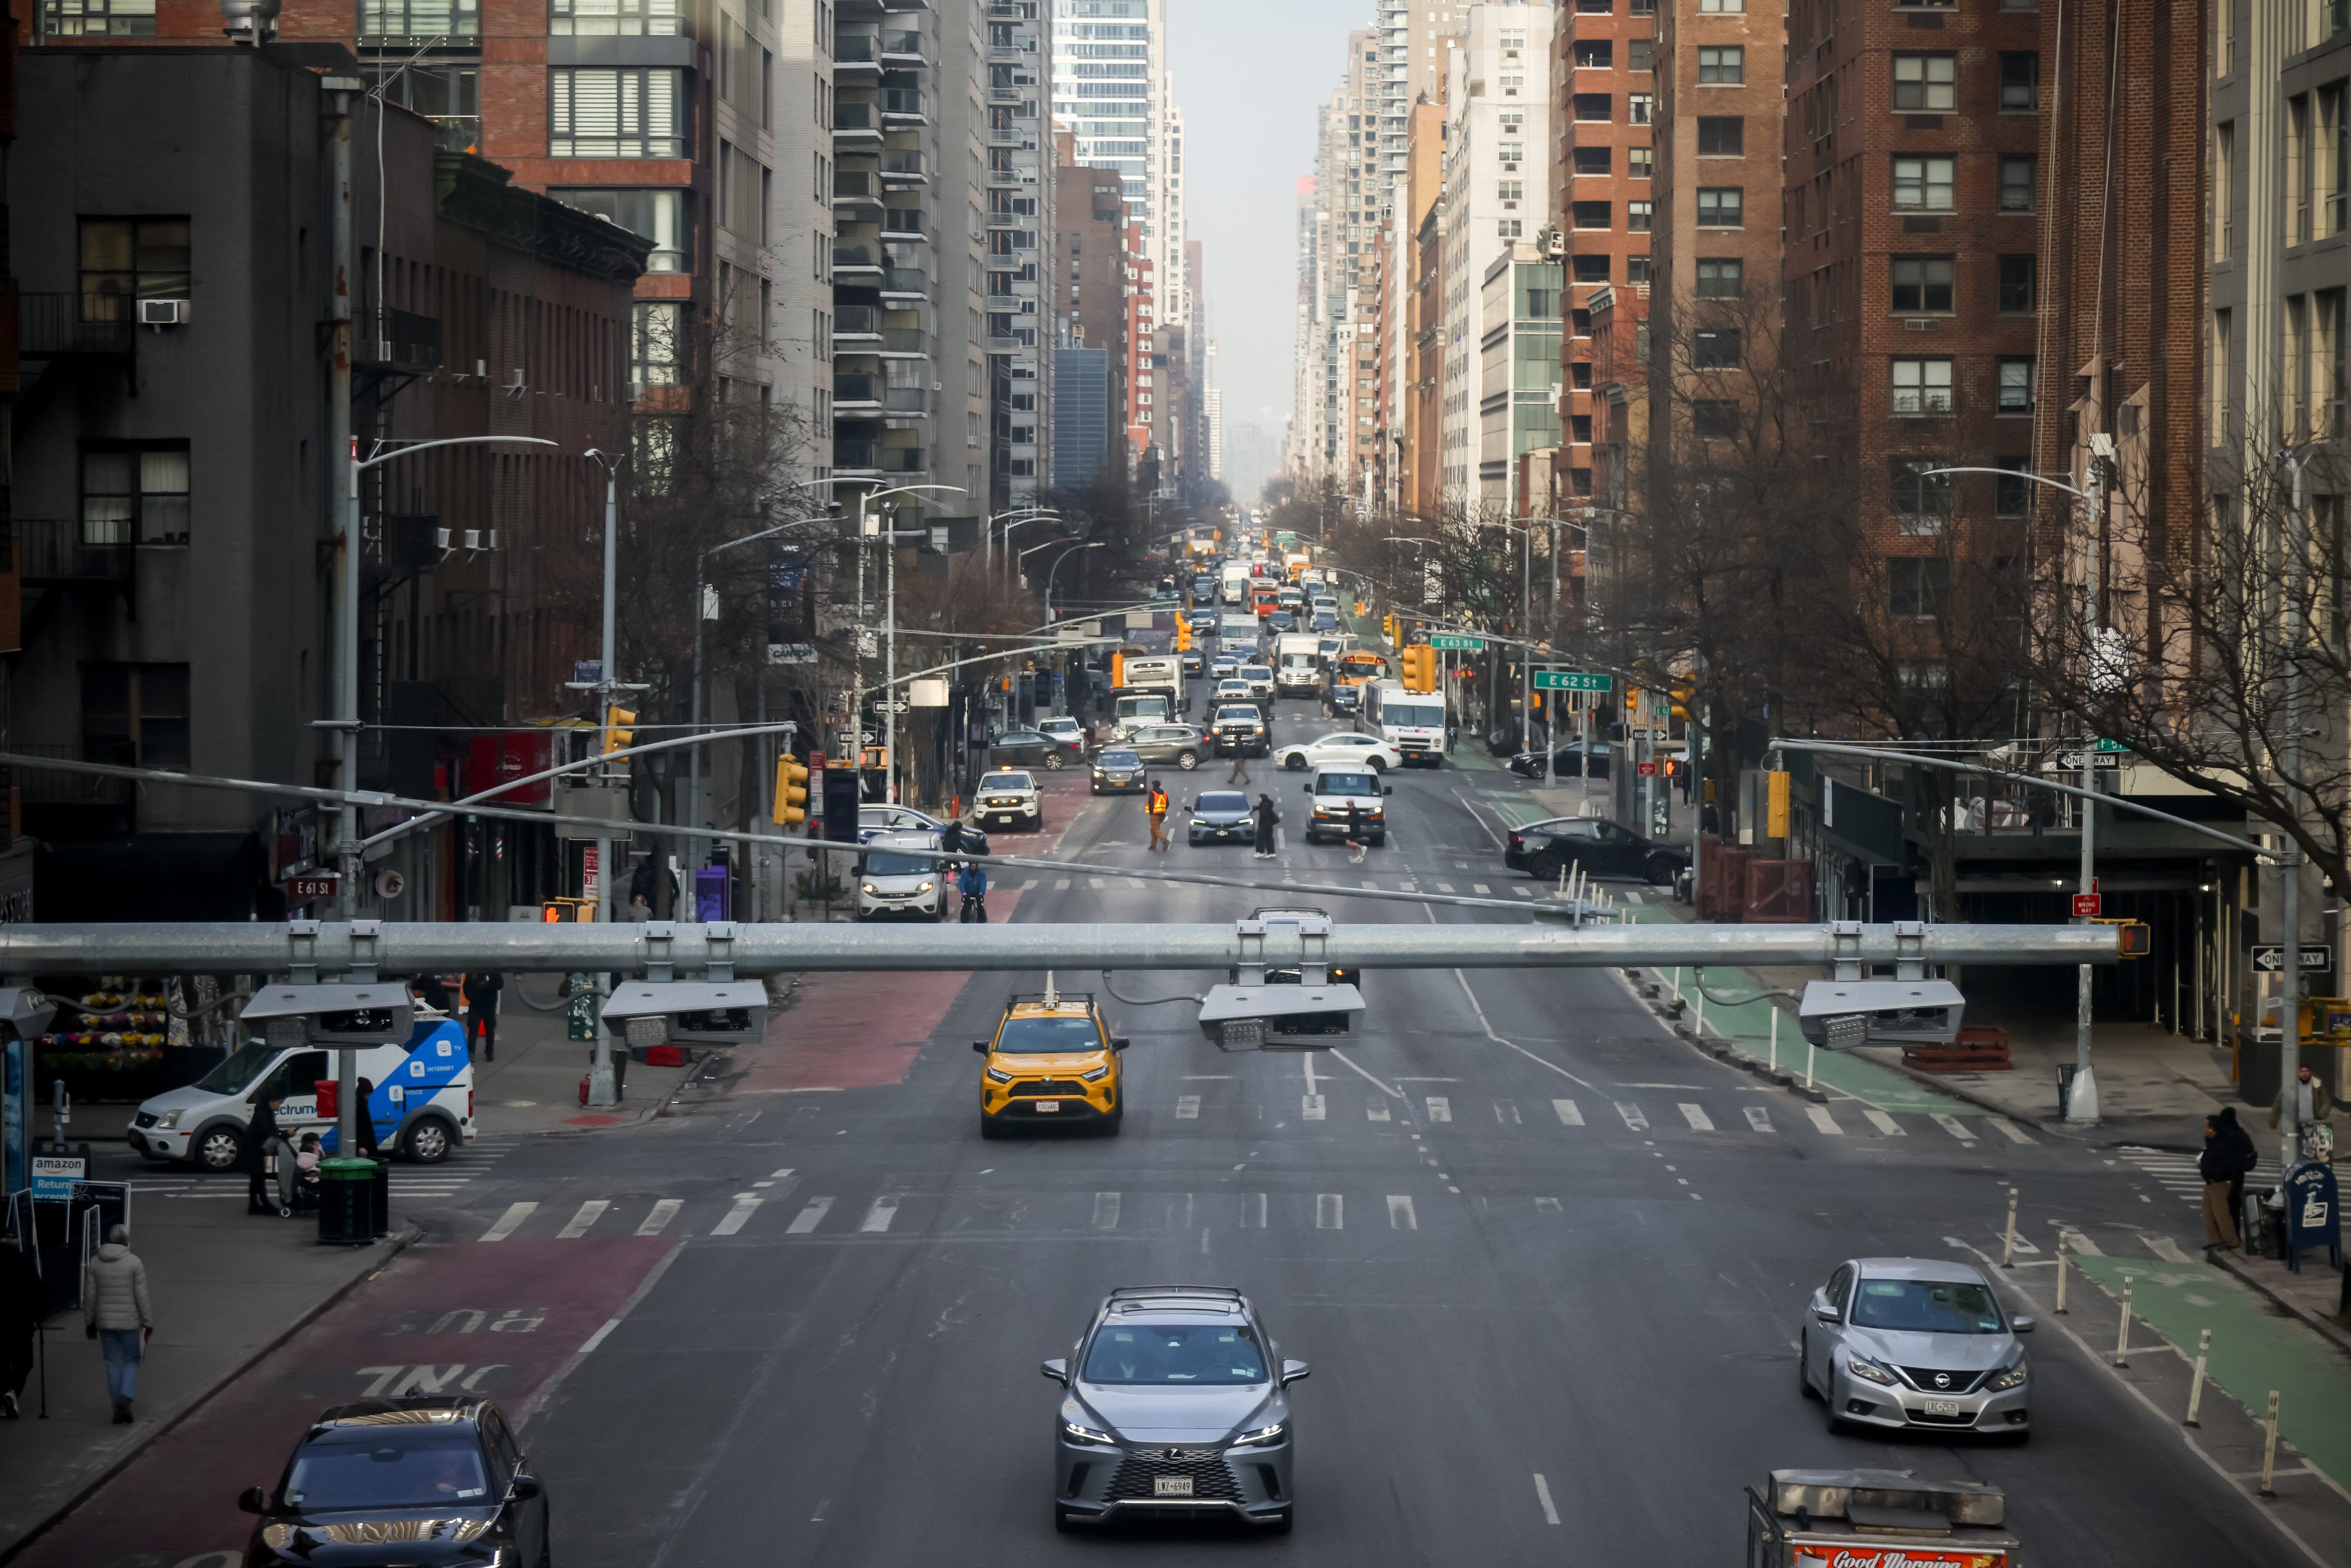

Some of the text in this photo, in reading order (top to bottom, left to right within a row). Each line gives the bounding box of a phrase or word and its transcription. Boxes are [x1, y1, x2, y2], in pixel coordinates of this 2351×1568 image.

[1549, 676, 1598, 688] E 62 St
[587, 876, 591, 884] 3
[298, 882, 329, 894] E 61 St
[36, 1160, 81, 1169] amazon
[1833, 1550, 1883, 1568] Good
